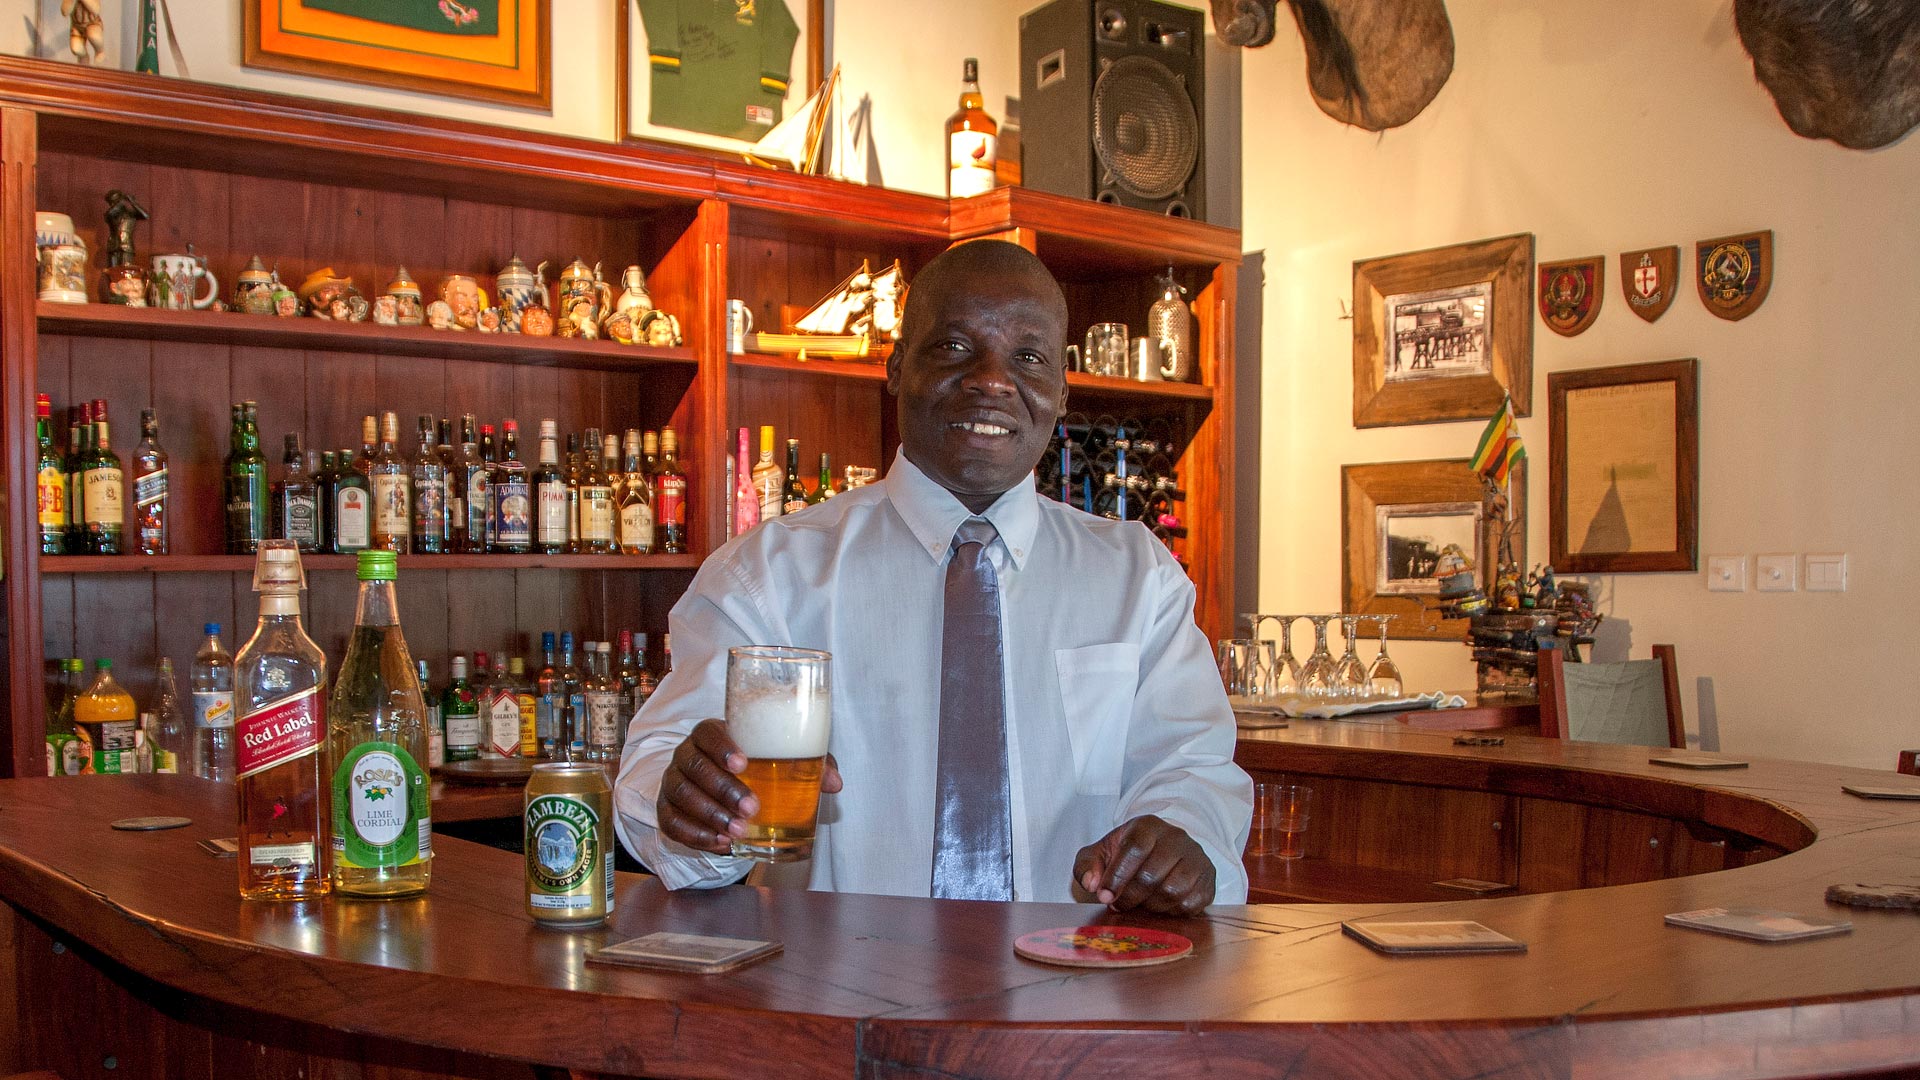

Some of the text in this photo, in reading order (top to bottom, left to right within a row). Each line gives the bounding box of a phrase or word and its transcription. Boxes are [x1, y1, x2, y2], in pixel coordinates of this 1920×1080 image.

[248, 704, 308, 730] JOHNNIE WALKER
[243, 727, 274, 748] Red
[354, 769, 404, 789] ROSE'S
[357, 818, 403, 828] CORDIAL
[367, 810, 393, 819] LIME
[527, 800, 593, 829] ZAMBEZI
[559, 874, 579, 886] OWN
[579, 848, 593, 874] LAGER
